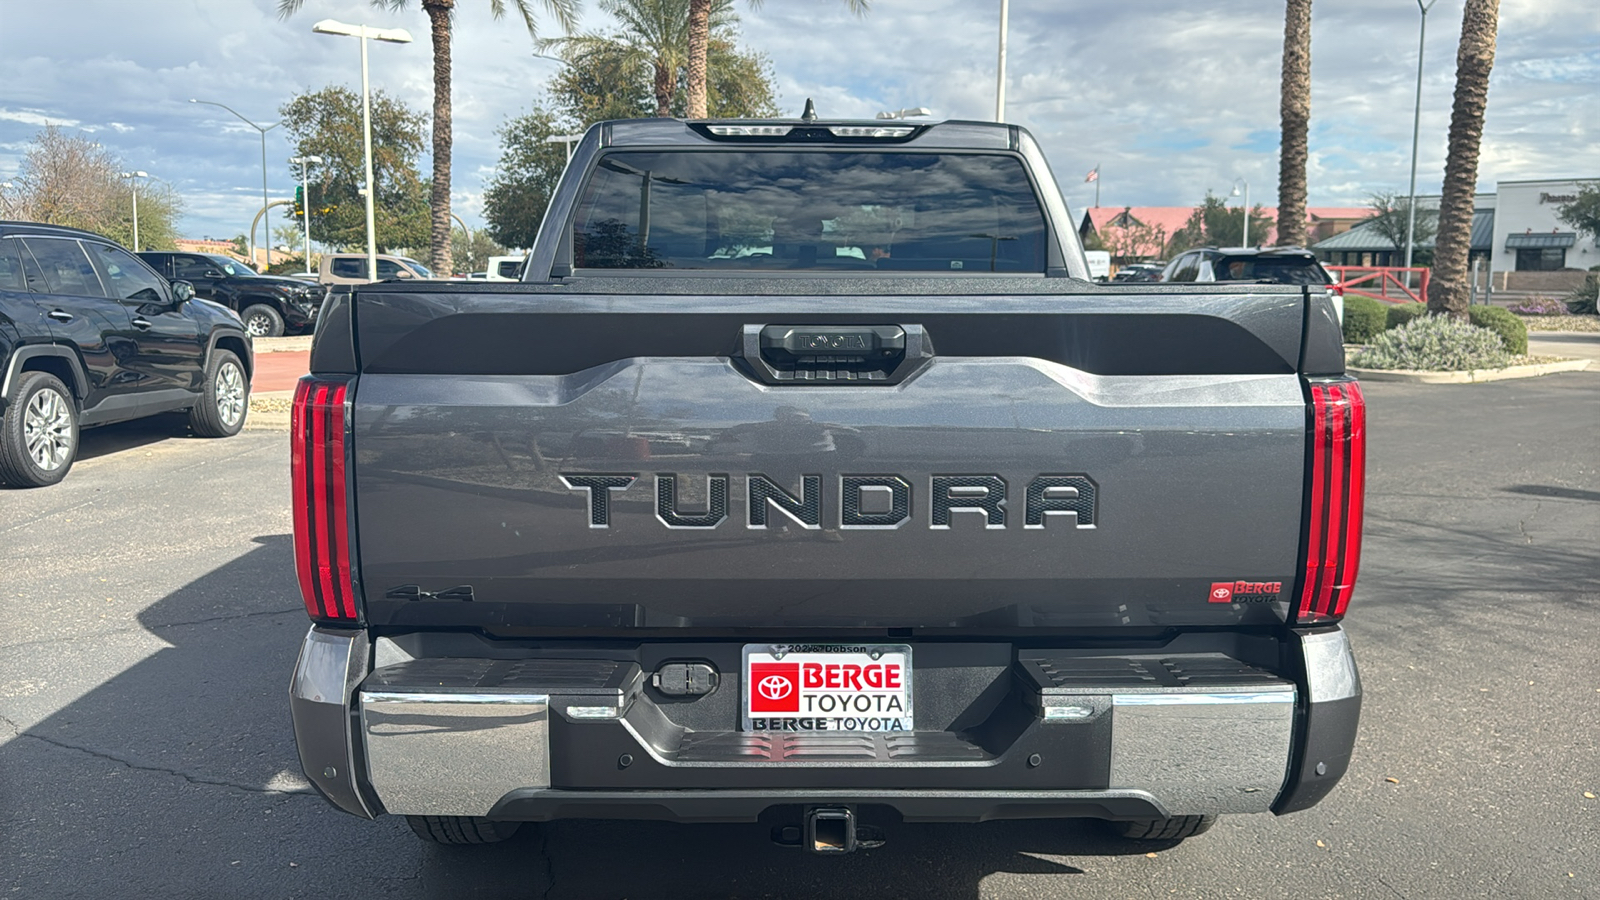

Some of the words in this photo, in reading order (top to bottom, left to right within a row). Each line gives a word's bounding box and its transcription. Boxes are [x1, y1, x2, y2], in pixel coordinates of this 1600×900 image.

[800, 335, 865, 348] TOYOTA
[558, 472, 1099, 530] TUNDRA
[1234, 581, 1282, 594] BERGE
[1234, 595, 1278, 603] TOYOTA
[825, 645, 867, 653] Dobson
[803, 663, 901, 691] BERGE
[803, 694, 903, 712] TOYOTA
[753, 718, 827, 731] BERGE
[834, 718, 903, 731] TOYOTA
